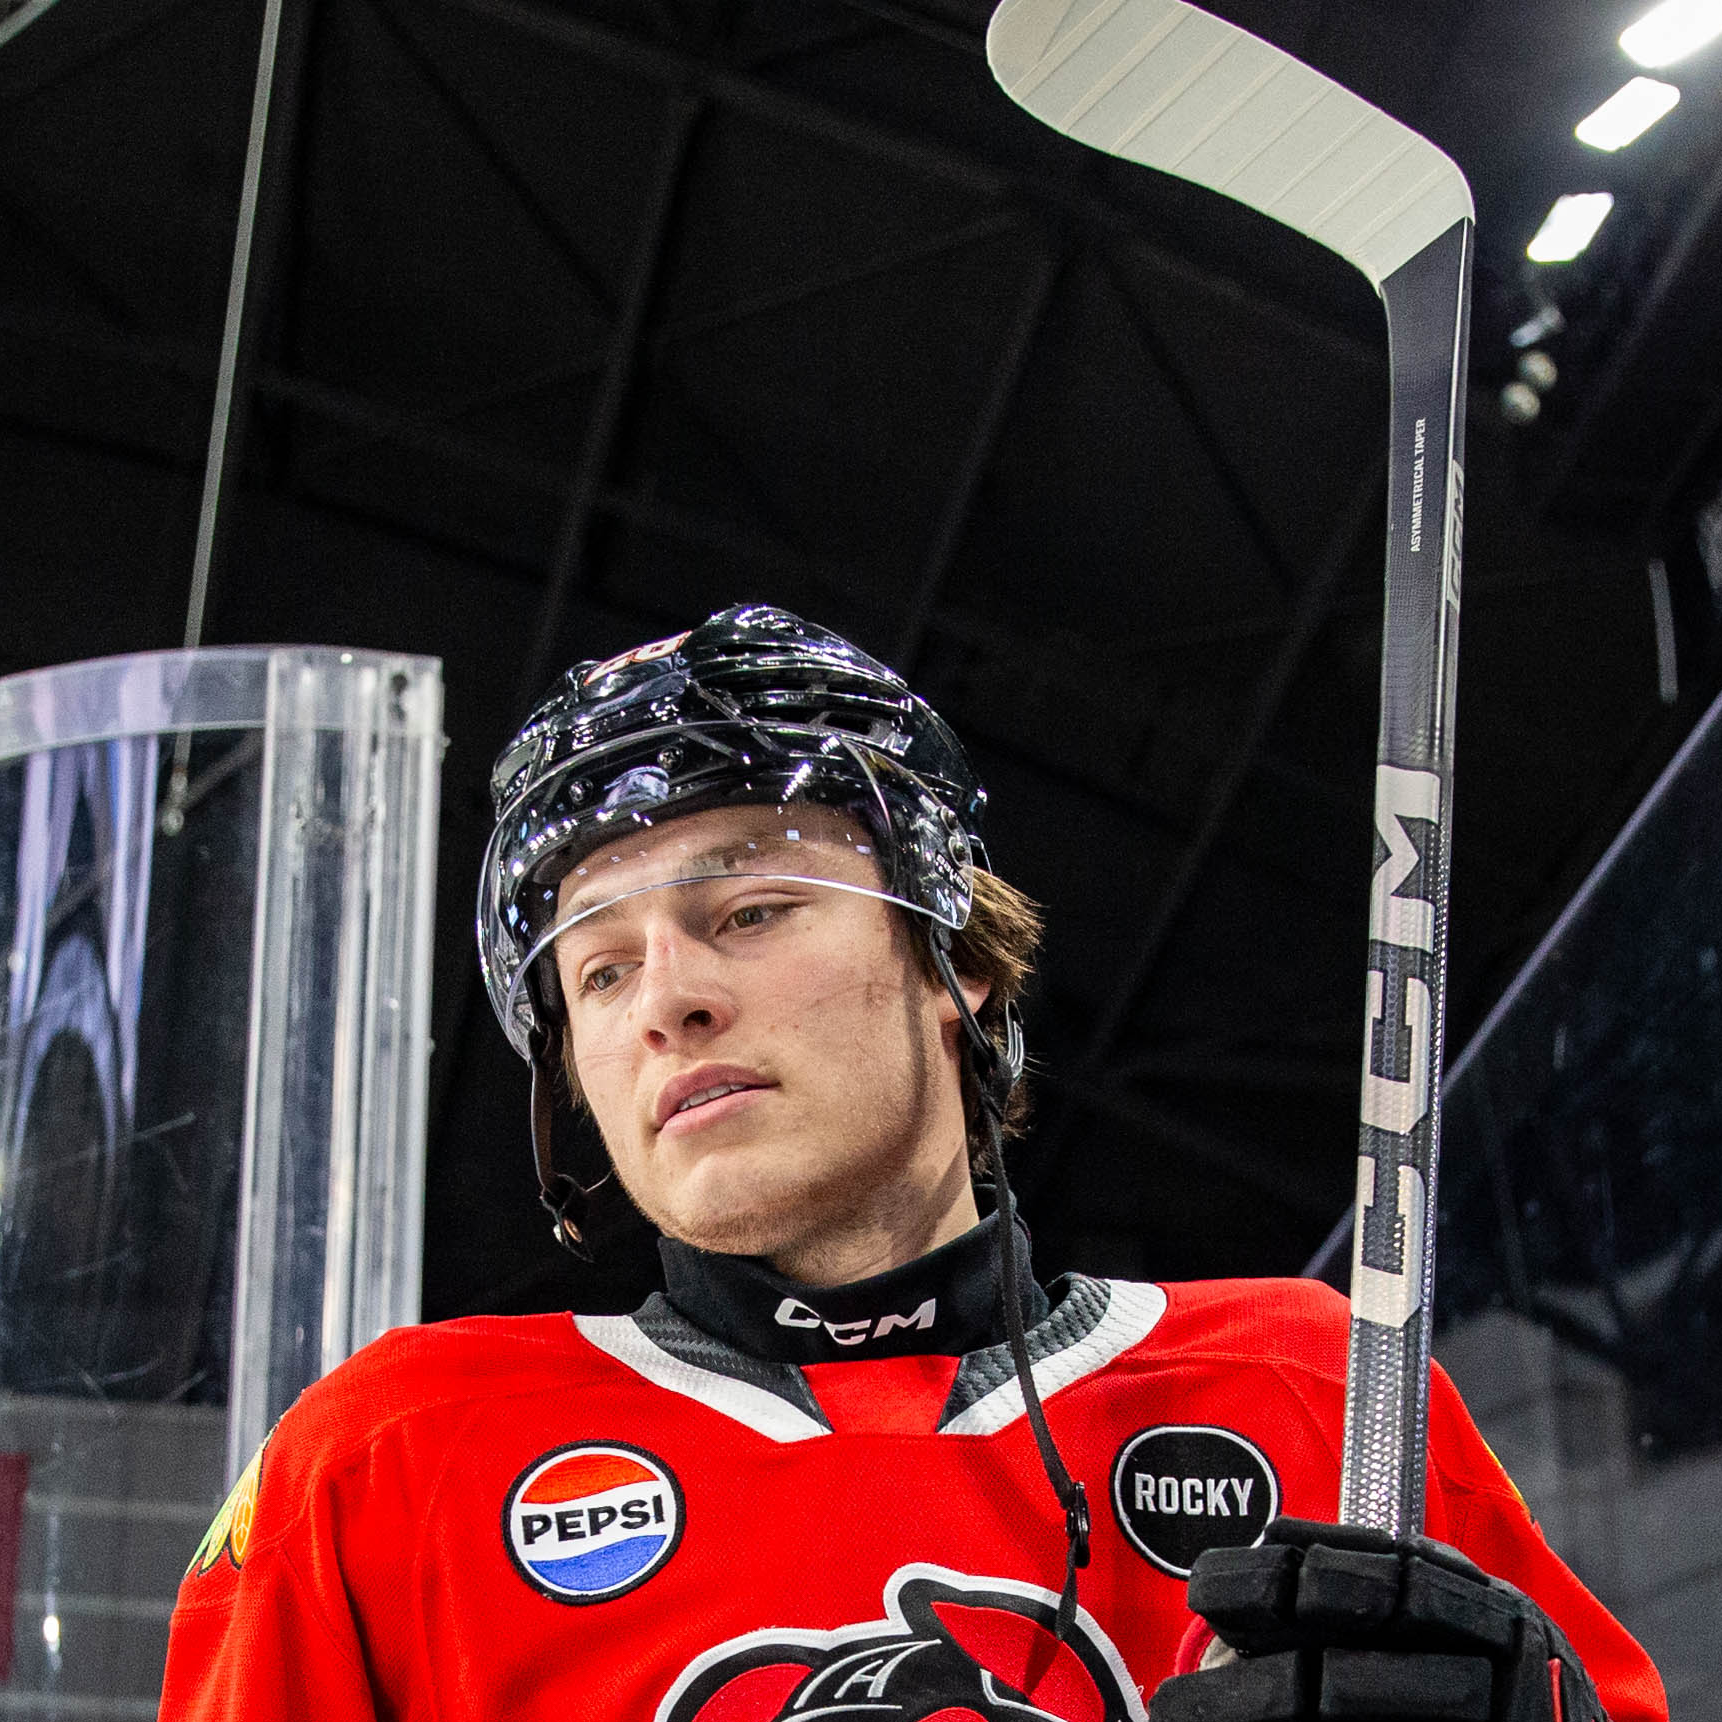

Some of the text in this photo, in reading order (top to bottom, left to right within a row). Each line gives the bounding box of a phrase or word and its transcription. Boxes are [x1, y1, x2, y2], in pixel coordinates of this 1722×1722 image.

[1410, 417, 1426, 552] ASYMMETRICAL TAPER
[1350, 765, 1440, 1329] CCM
[774, 1297, 936, 1346] CCM
[521, 1493, 666, 1546] PEPSI
[1134, 1471, 1254, 1517] ROCKY
